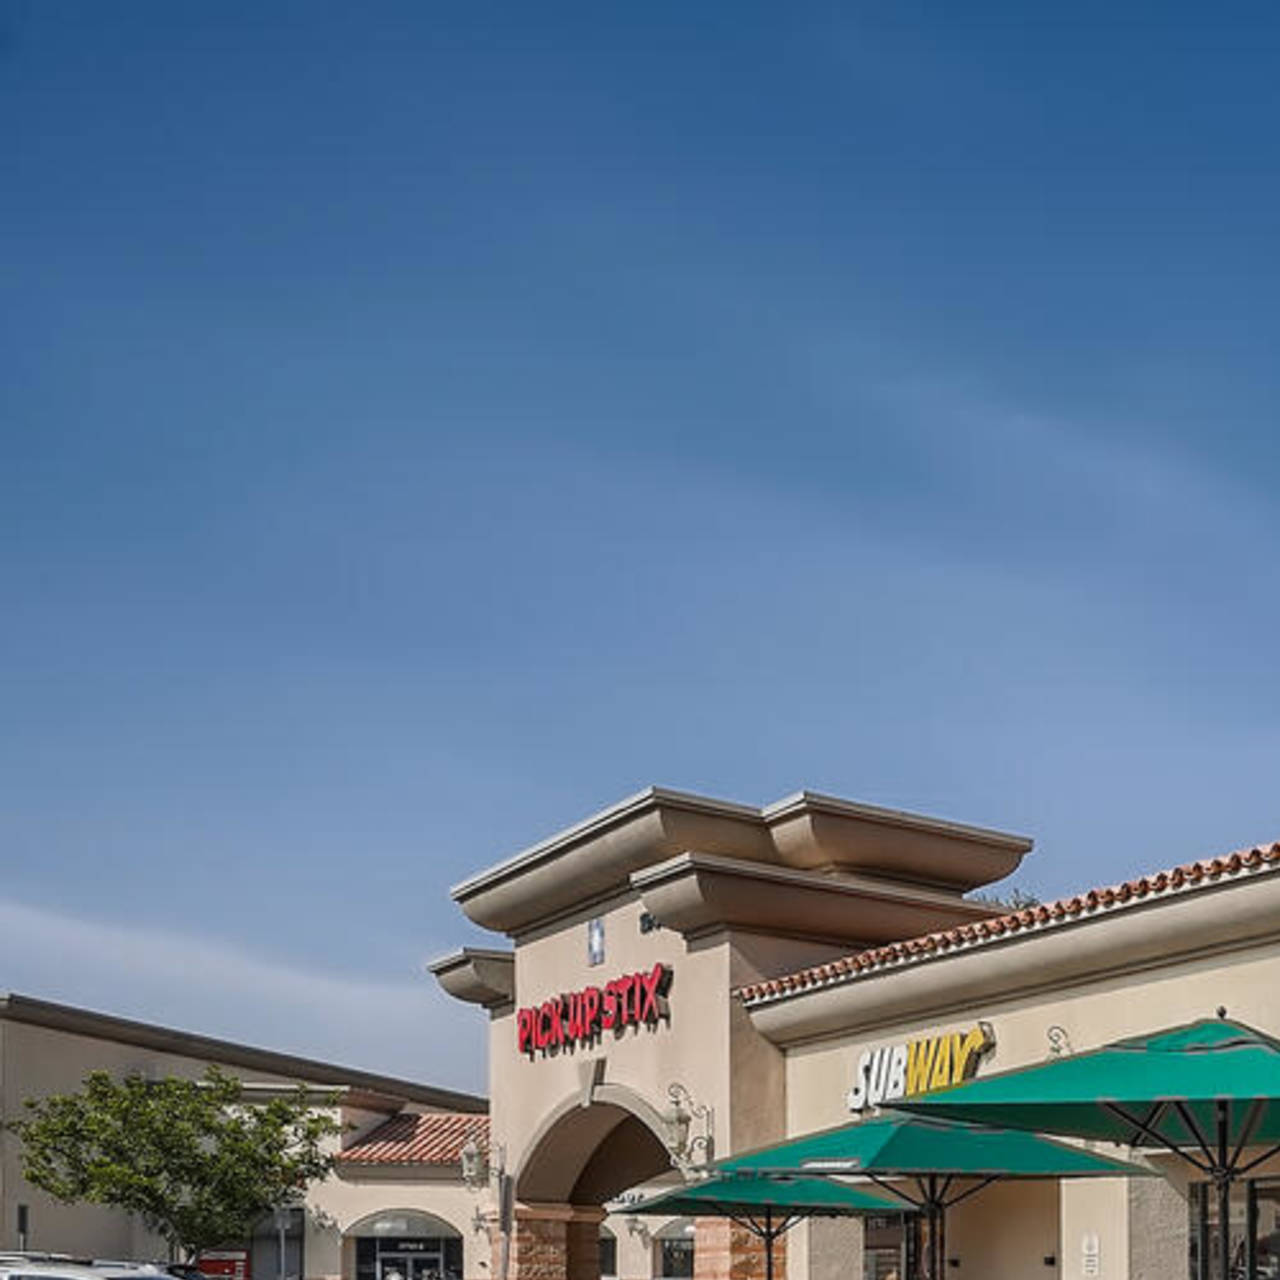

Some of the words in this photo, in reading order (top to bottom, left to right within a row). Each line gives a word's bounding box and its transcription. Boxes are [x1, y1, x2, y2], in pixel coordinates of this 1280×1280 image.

[518, 1002, 565, 1053] PICK
[602, 962, 662, 1030] STIX
[849, 1027, 985, 1108] SUBWAY
